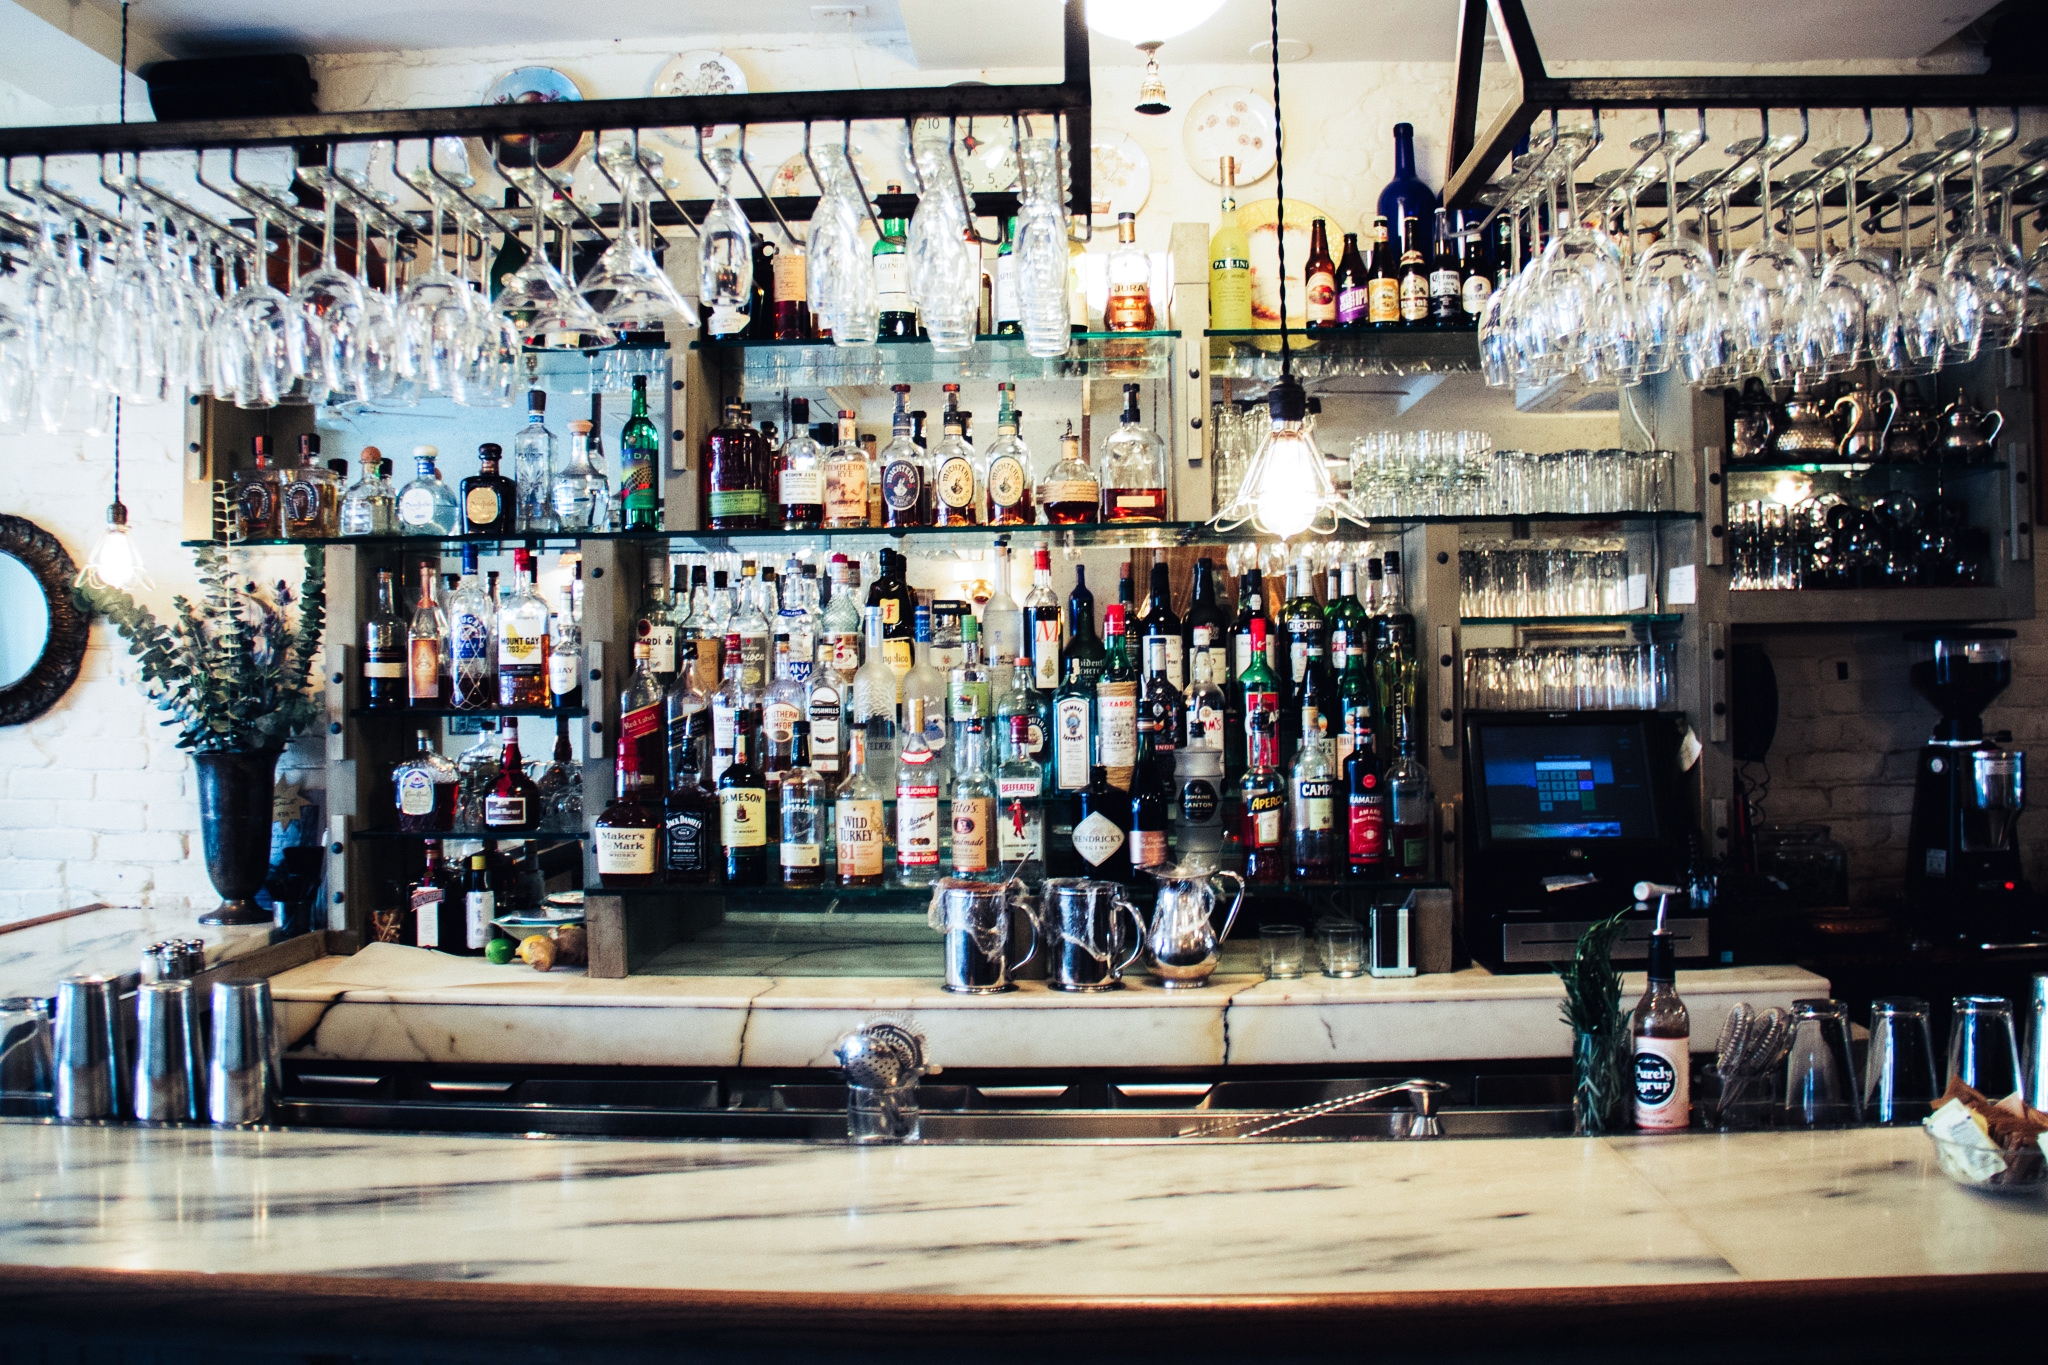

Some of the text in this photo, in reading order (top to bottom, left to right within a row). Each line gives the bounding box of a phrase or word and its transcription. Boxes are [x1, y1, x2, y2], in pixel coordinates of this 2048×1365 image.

[927, 117, 940, 130] 10
[1003, 160, 1010, 169] 4
[988, 173, 995, 184] 5
[1431, 273, 1458, 282] Crona
[1114, 285, 1145, 293] JURA
[622, 453, 651, 462] VIDA
[826, 464, 865, 472] TEMPLETON
[942, 464, 970, 482] MICHTER'S
[886, 604, 895, 619] F
[1288, 620, 1322, 630] RICARD
[1036, 620, 1058, 642] M
[501, 637, 540, 646] MOUNT GAY
[882, 652, 910, 664] ngelico
[1080, 658, 1104, 667] sident
[809, 707, 840, 715] BUSHMILLS
[1063, 704, 1083, 713] BOMBAY
[763, 710, 798, 720] SOUTHERN
[624, 713, 656, 730] Red Label
[1203, 717, 1222, 731] MM'S
[866, 742, 892, 750] VEDERE
[897, 786, 937, 796] STOLICHNAYA
[1001, 783, 1035, 794] BEEFEATER
[1302, 784, 1333, 796] CAMP
[721, 793, 762, 804] JAMESON
[1350, 795, 1384, 804] RAMAZZO
[952, 801, 979, 814] Tito's
[666, 814, 702, 830] JACK DANIEL'S
[843, 815, 868, 828] WILD
[601, 831, 646, 841] Maker's
[839, 829, 873, 842] TURKEY
[1073, 835, 1122, 844] HENDRICK'S
[613, 841, 646, 850] Mark
[840, 843, 855, 860] 81
[920, 854, 938, 863] VODKA
[1636, 1065, 1672, 1081] Purely
[1636, 1081, 1672, 1094] Syrup
